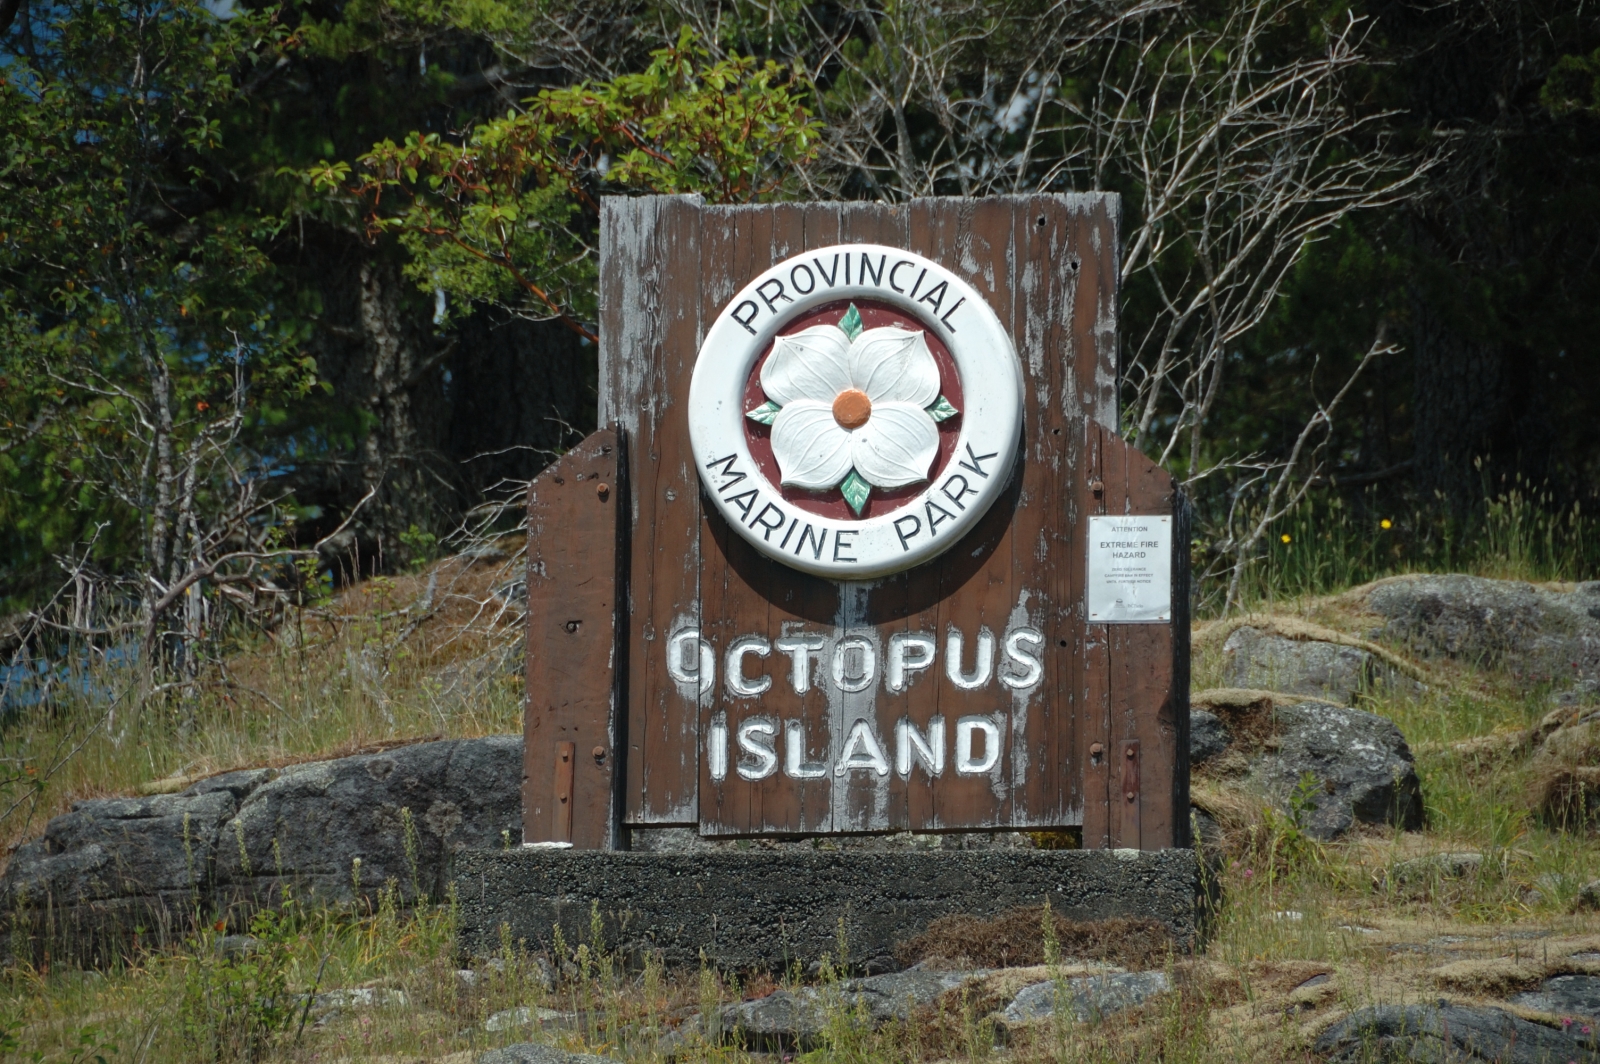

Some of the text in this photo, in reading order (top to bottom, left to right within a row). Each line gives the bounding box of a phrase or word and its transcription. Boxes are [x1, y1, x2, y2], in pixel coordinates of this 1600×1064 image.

[730, 252, 967, 335] PROVINCIAL
[706, 441, 999, 563] MARINE PARK
[1100, 541, 1138, 549] EXTREME
[1112, 551, 1146, 559] HAZARD
[666, 626, 1043, 695] OCTOPUS
[709, 717, 1000, 780] ISLAND
